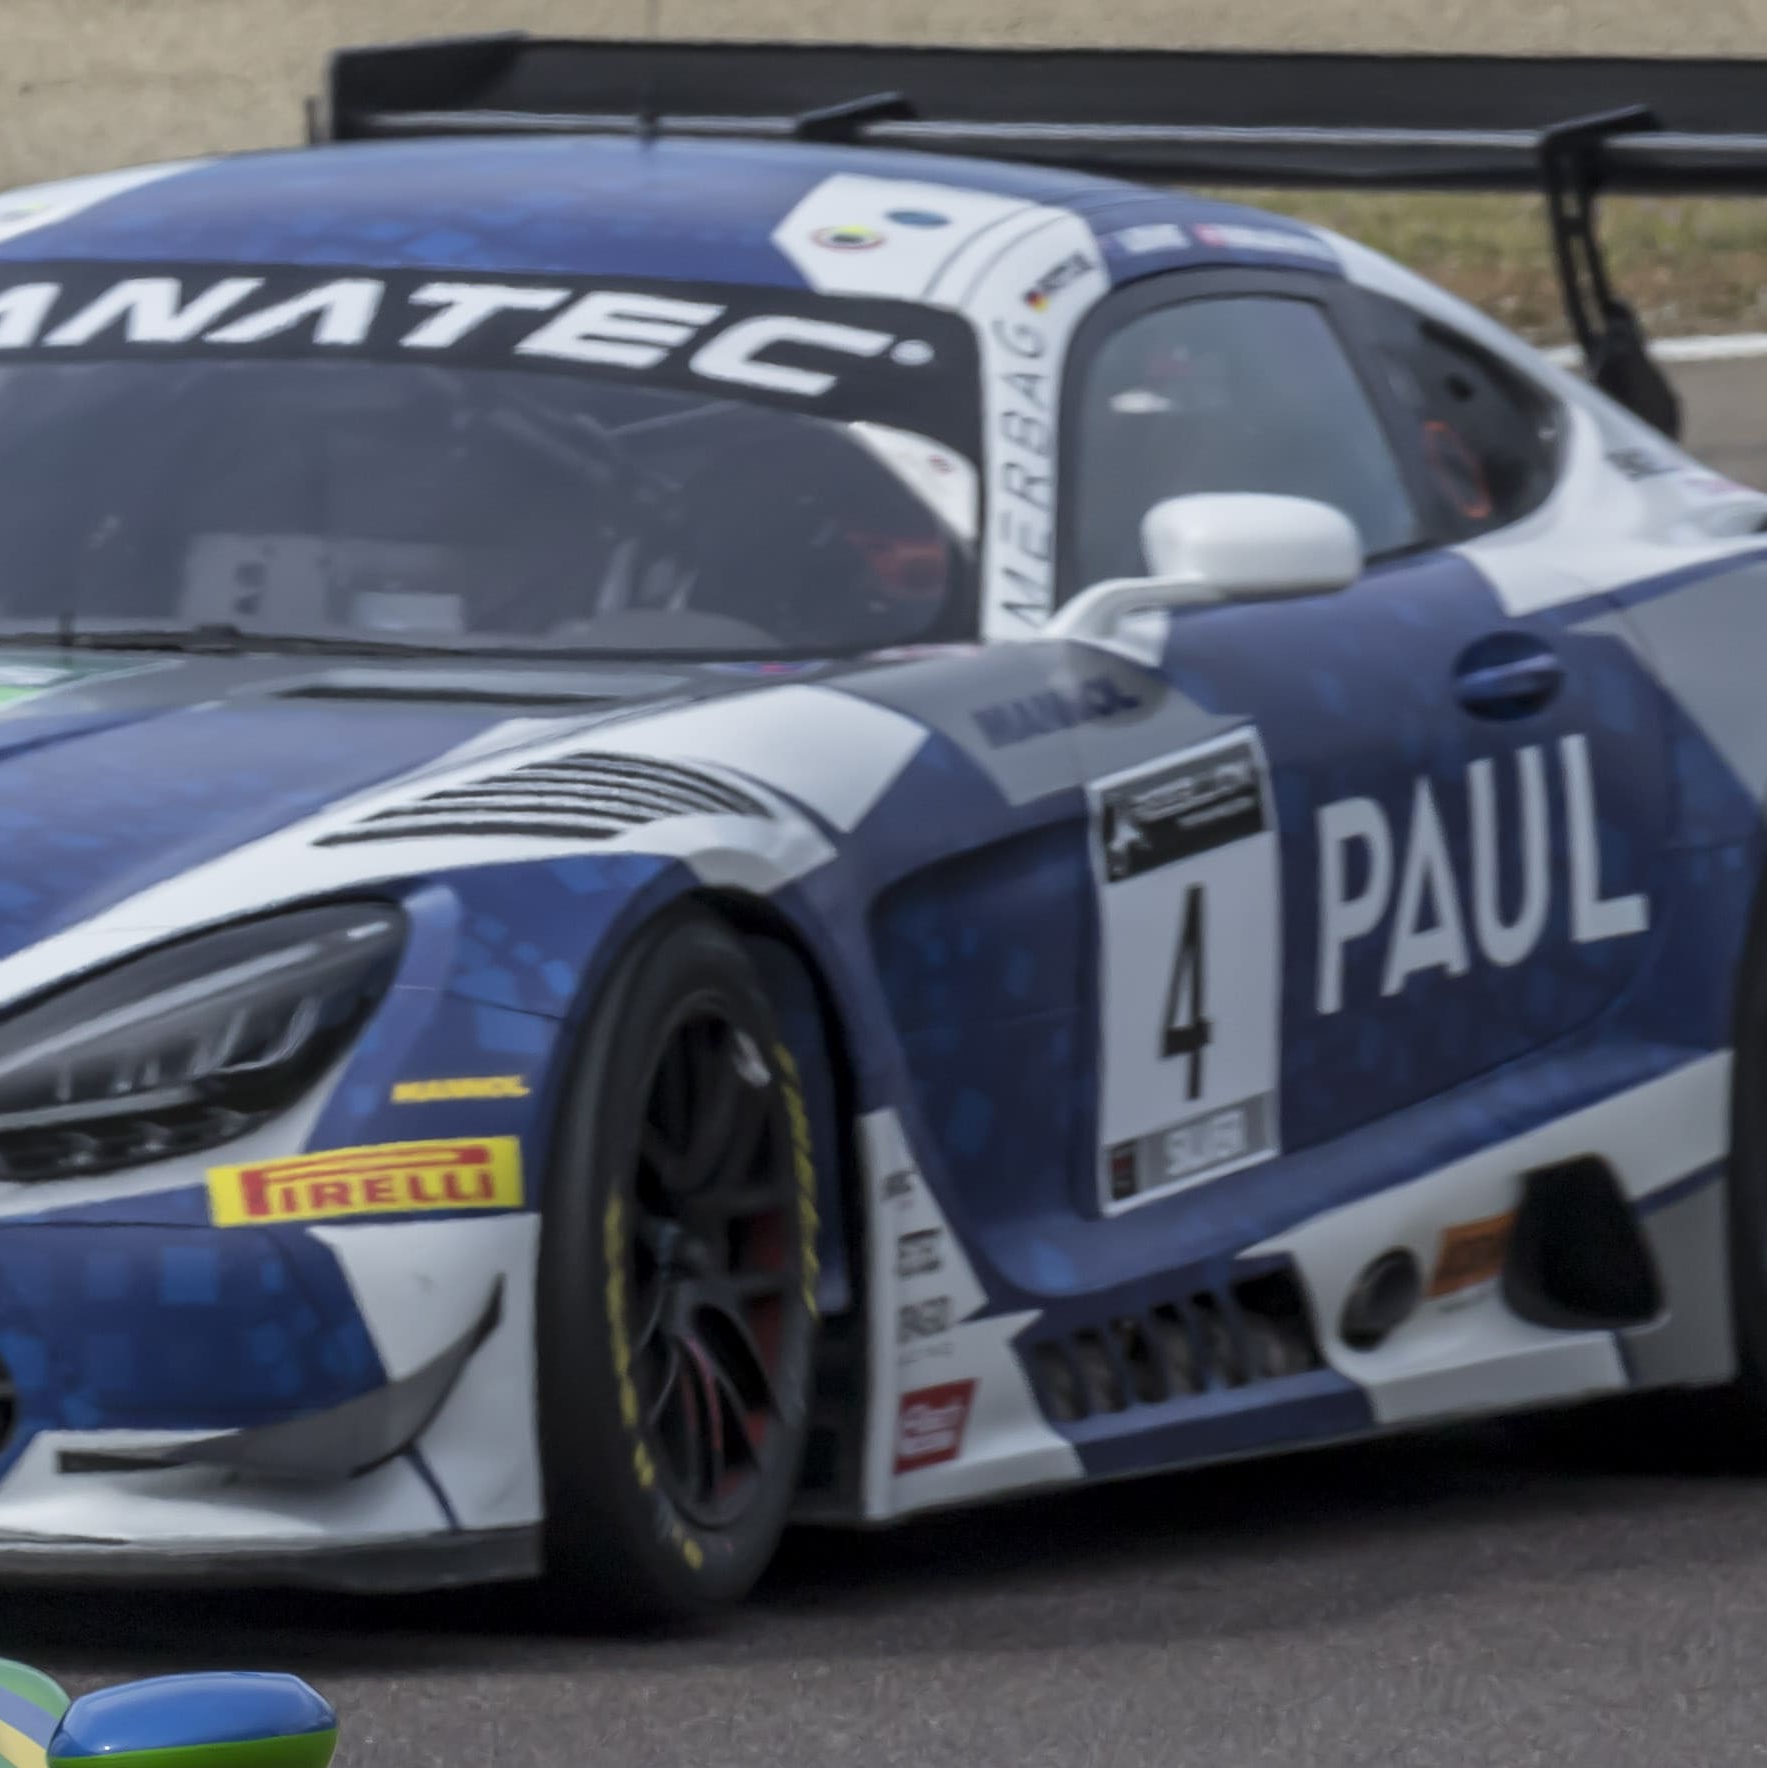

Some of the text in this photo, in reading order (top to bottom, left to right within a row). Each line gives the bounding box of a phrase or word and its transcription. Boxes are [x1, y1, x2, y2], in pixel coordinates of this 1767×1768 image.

[1315, 733, 1650, 1015] PAUL
[1157, 882, 1213, 1101] 4
[239, 1143, 495, 1218] PIRELLI
